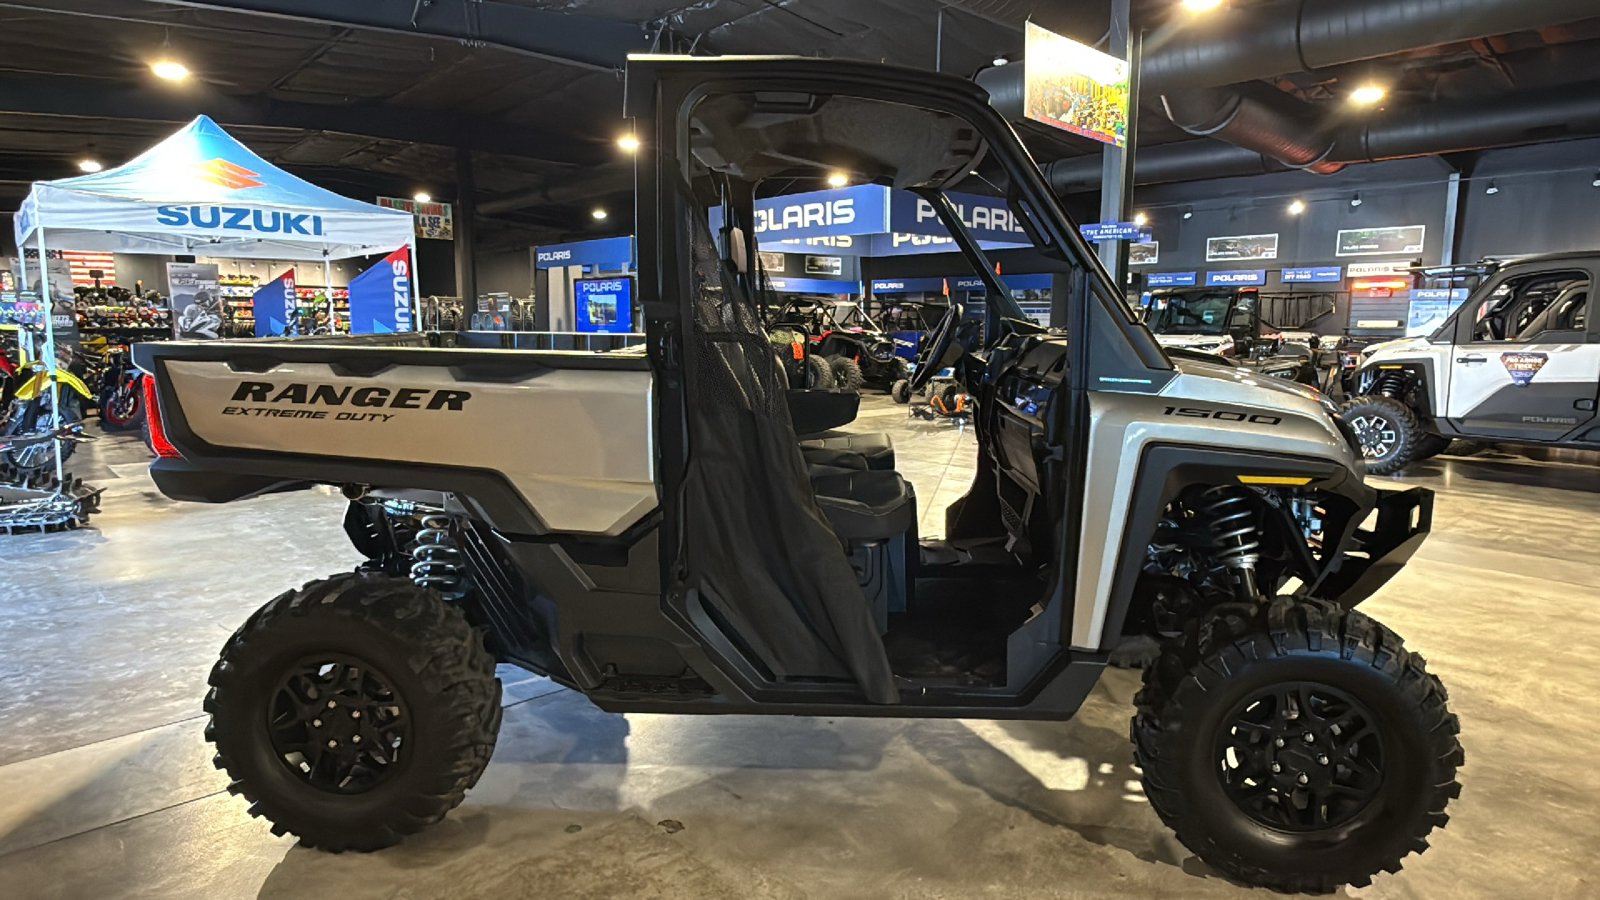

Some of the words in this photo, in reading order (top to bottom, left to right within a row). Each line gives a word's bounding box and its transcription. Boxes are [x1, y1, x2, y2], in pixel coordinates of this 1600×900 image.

[156, 206, 323, 236] SUZUKI
[754, 198, 856, 233] OLARIS
[1100, 227, 1133, 235] AMERICAN
[538, 250, 571, 262] POLARIS
[1212, 274, 1258, 282] POLARIS
[583, 281, 622, 292] POLARIS
[392, 259, 410, 332] SUZUK
[231, 381, 472, 411] RANGER
[222, 406, 329, 420] EXTREME
[335, 412, 396, 422] DUTY
[1163, 406, 1273, 425] 1500
[1522, 416, 1577, 424] POLARIS
